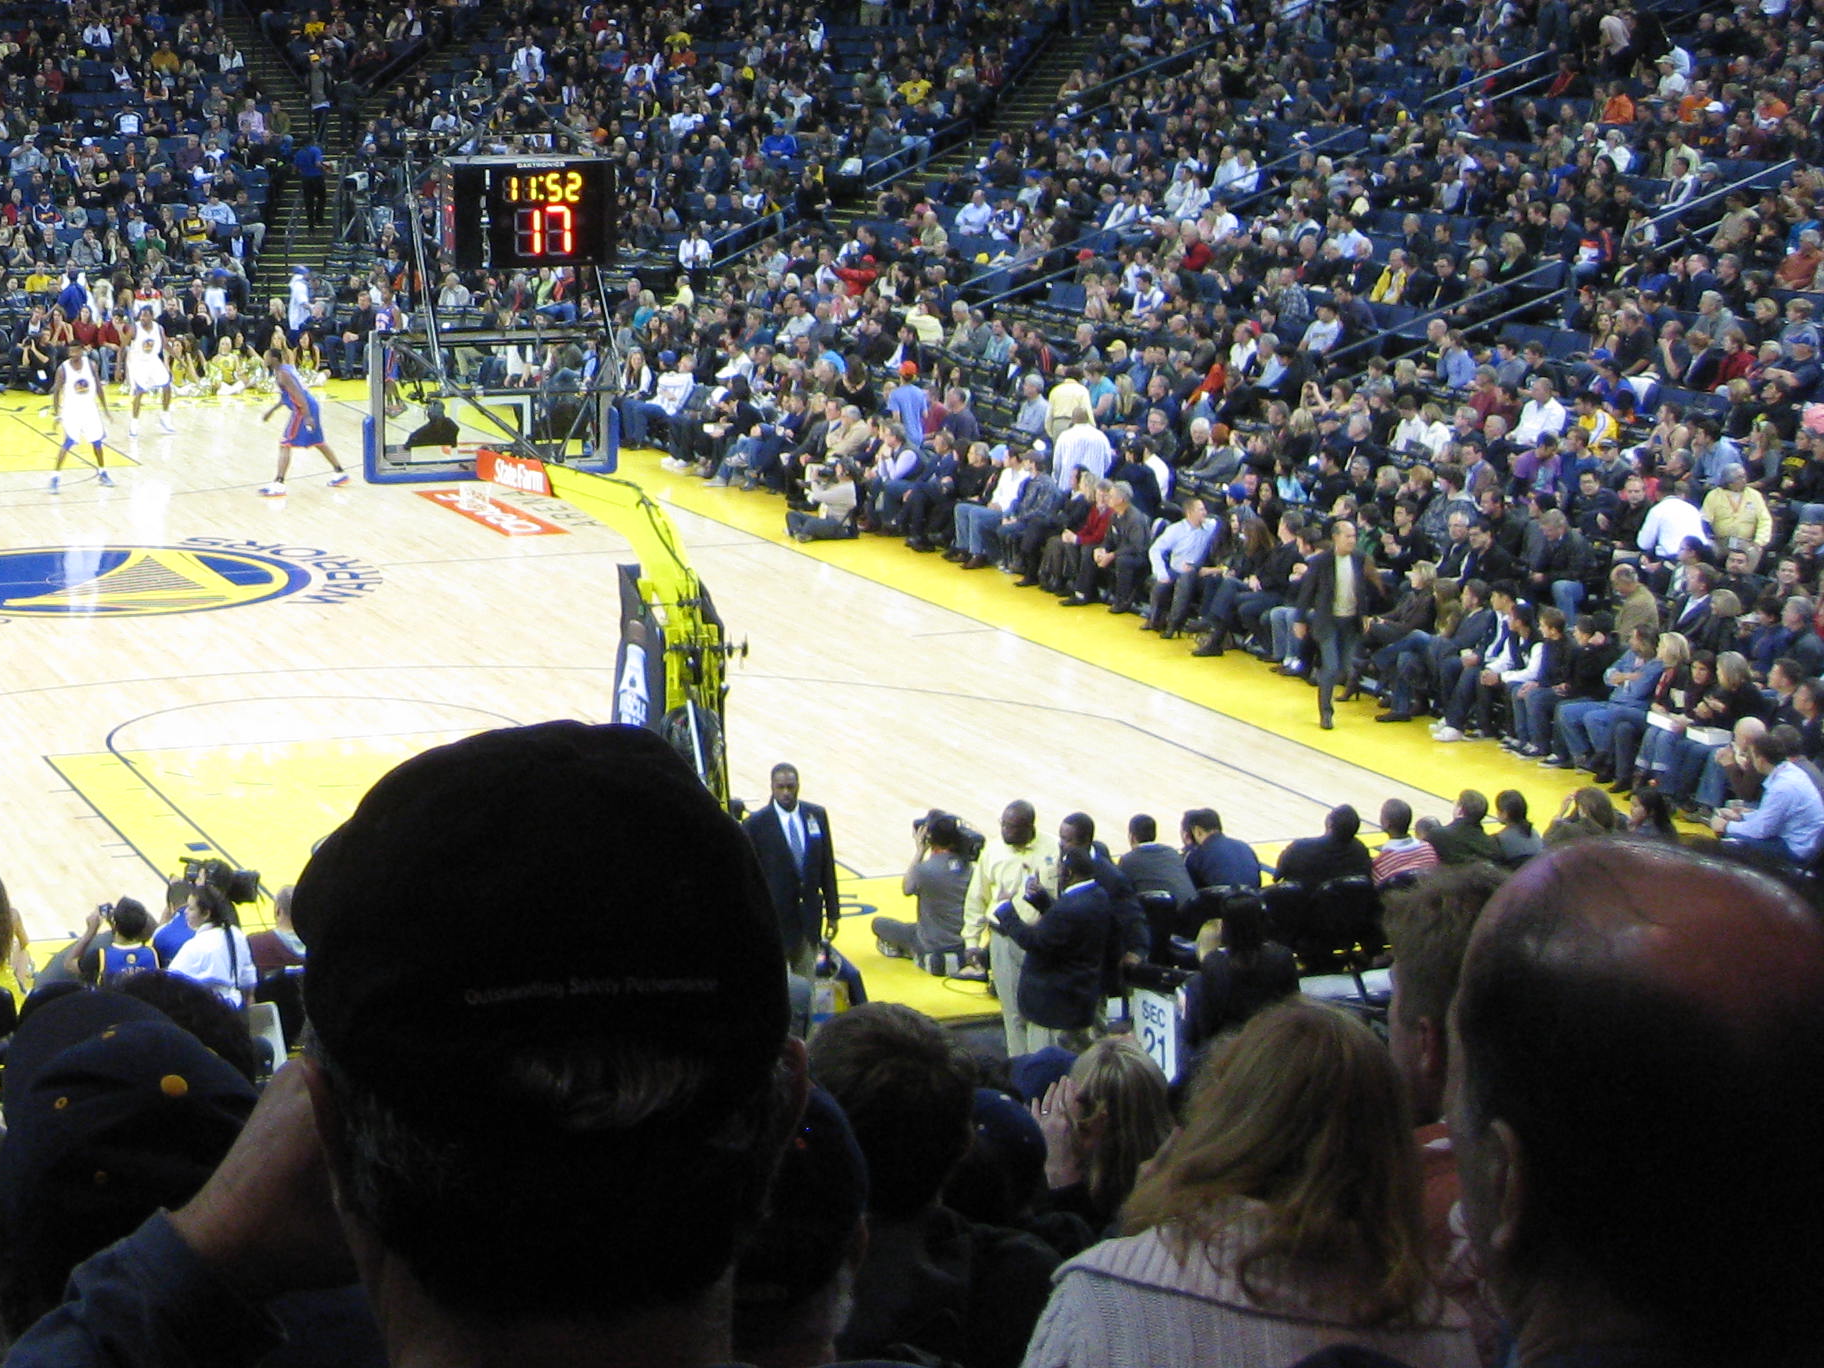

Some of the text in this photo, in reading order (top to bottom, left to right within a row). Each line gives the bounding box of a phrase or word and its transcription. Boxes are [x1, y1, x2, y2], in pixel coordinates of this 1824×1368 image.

[510, 172, 582, 202] 11:52
[532, 204, 573, 255] 17
[175, 535, 384, 605] WARRIORS
[1141, 999, 1166, 1029] SEC
